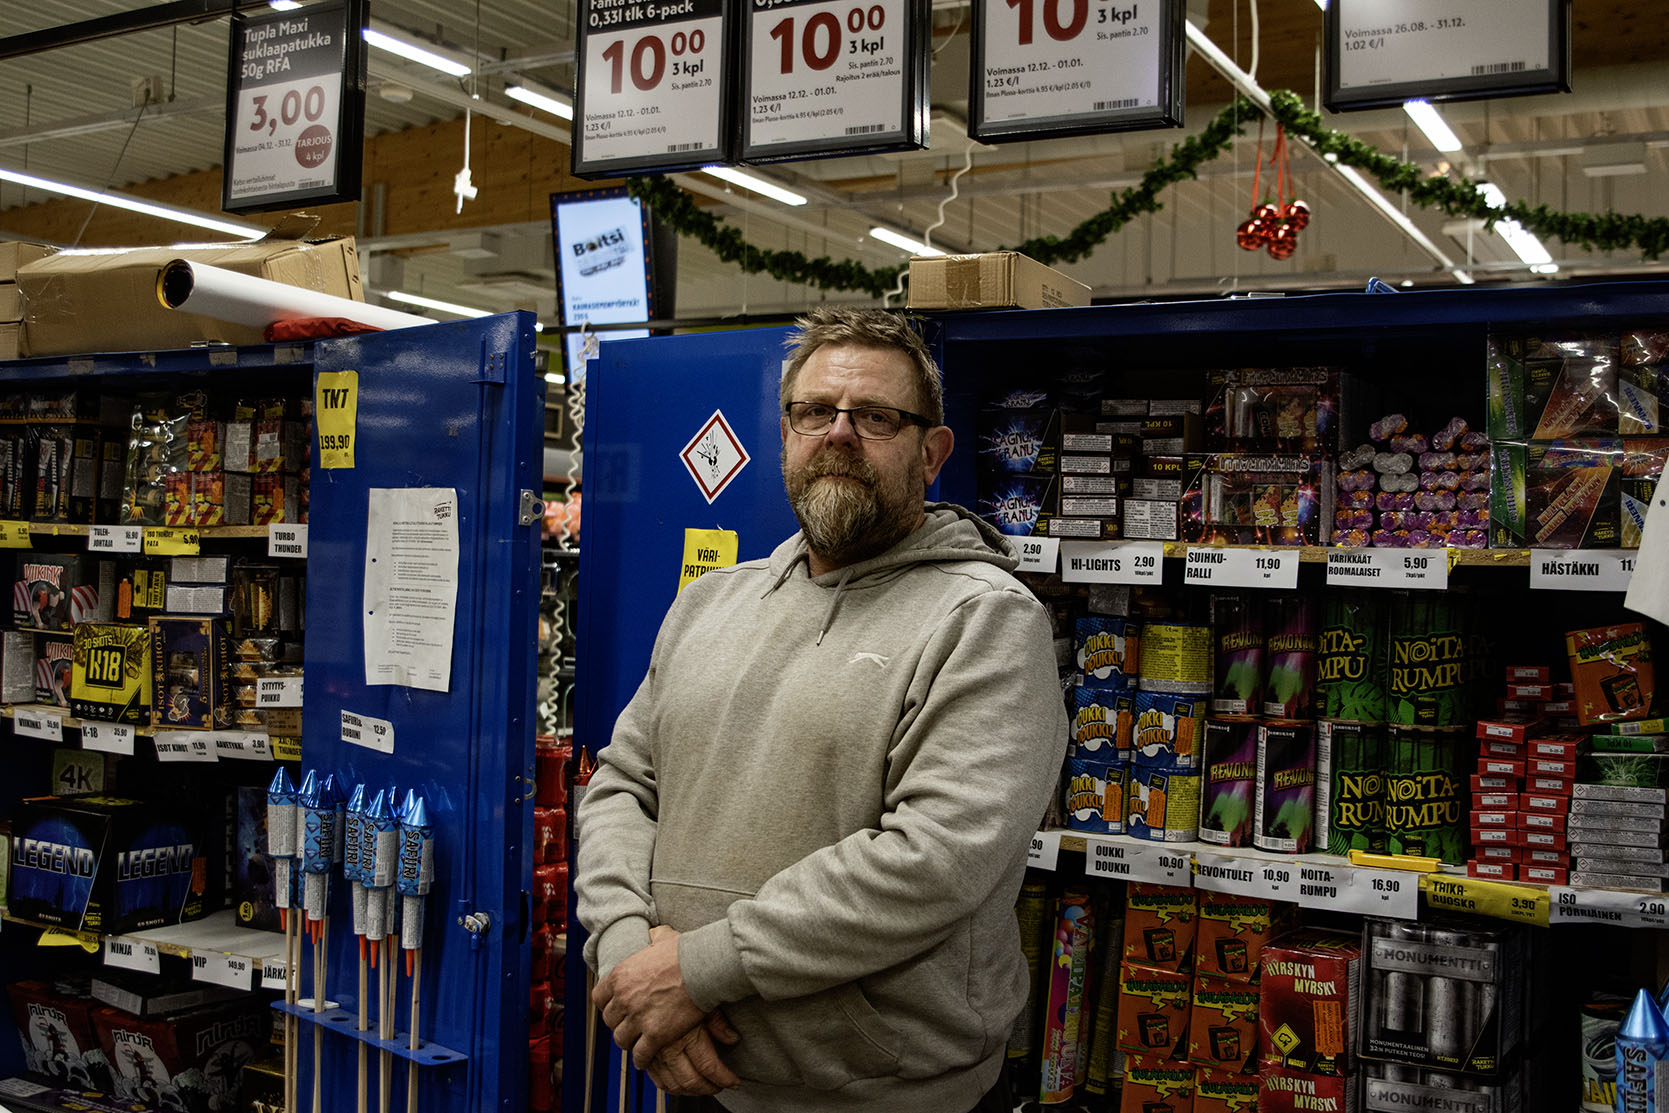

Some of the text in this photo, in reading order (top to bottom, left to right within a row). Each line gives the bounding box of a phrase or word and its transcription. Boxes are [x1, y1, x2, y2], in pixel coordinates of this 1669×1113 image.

[589, 1, 694, 28] 0,33l tlk 6-pack
[1097, 6, 1137, 25] 3 kpl
[244, 18, 308, 44] Tupla Maxi
[1096, 27, 1149, 41] Sis. pantin 2.70
[1344, 18, 1466, 39] Voimassa 26.08. 31.12.
[242, 34, 331, 61] suklaapatukka
[770, 12, 842, 74] 10
[849, 36, 884, 55] 3 kpl
[1344, 40, 1365, 51] 1.02
[241, 57, 291, 80] 50g RFA
[602, 35, 666, 94] 10
[672, 59, 704, 77] 3 kpl
[848, 57, 894, 70] Sis. pantin 2.70
[986, 58, 1084, 77] Voimassa 12.12. 01.01.
[681, 80, 699, 91] pantin
[699, 78, 712, 87] 2.70
[836, 73, 860, 83] Rajoitus
[866, 70, 901, 80] erää/talous
[986, 78, 1004, 88] 1.23
[752, 86, 837, 104] Voimassa 12.12. 01.01.
[250, 85, 325, 137] 3,00
[585, 106, 661, 121] Voimassa 12.12. 01.01.
[752, 104, 768, 114] 1.23
[585, 123, 599, 132] 1.23
[297, 136, 331, 148] TARJOUS
[573, 228, 624, 257] Boltsi
[322, 389, 349, 409] TNT
[320, 435, 350, 451] 199,90
[1153, 463, 1183, 471] 10 KPL
[275, 532, 296, 541] TURBO
[275, 544, 303, 553] THUNDER
[697, 547, 720, 562] VÄRI-
[1023, 544, 1042, 555] 2,90
[1071, 556, 1155, 571] HI-LIGHTS 2,90
[1188, 552, 1281, 570] SUIHKU- 11,90
[1329, 553, 1428, 570] VÄRIKKÄÄT 5,90
[1542, 560, 1600, 576] HÄSTÄKKI
[1186, 568, 1212, 579] RALLI
[1328, 566, 1381, 577] ROOMALAISET
[1085, 635, 1115, 657] OUKKI
[88, 648, 122, 683] K18
[262, 682, 286, 691] SYTYTYS-
[261, 693, 281, 703] PUIKKO
[60, 764, 93, 791] 4K
[1386, 801, 1461, 831] RUMPU
[13, 836, 96, 879] LEGEND
[117, 843, 194, 883] LEGEND
[1096, 845, 1184, 870] OUKKI 10,90
[1095, 860, 1130, 874] DOUKKI
[1262, 869, 1289, 882] 10,90
[1300, 868, 1400, 892] NOITA- 16,90
[1300, 884, 1337, 898] RUMPU
[1433, 881, 1468, 896] TAIKA-
[1433, 896, 1475, 910] RUOSKA
[1559, 893, 1576, 905] ISO
[1559, 906, 1622, 921] PÖRRIÄINEN
[110, 943, 132, 956] NINJA
[193, 955, 207, 968] VIP
[1383, 949, 1482, 972] MONUMENTTI
[1266, 959, 1315, 979] HYRSKYN
[1294, 978, 1337, 996] MYRSKY
[1265, 1075, 1315, 1095] HYRSKYN
[1294, 1093, 1338, 1112] MYRSKY
[1378, 1090, 1475, 1112] MONUMENTTI
